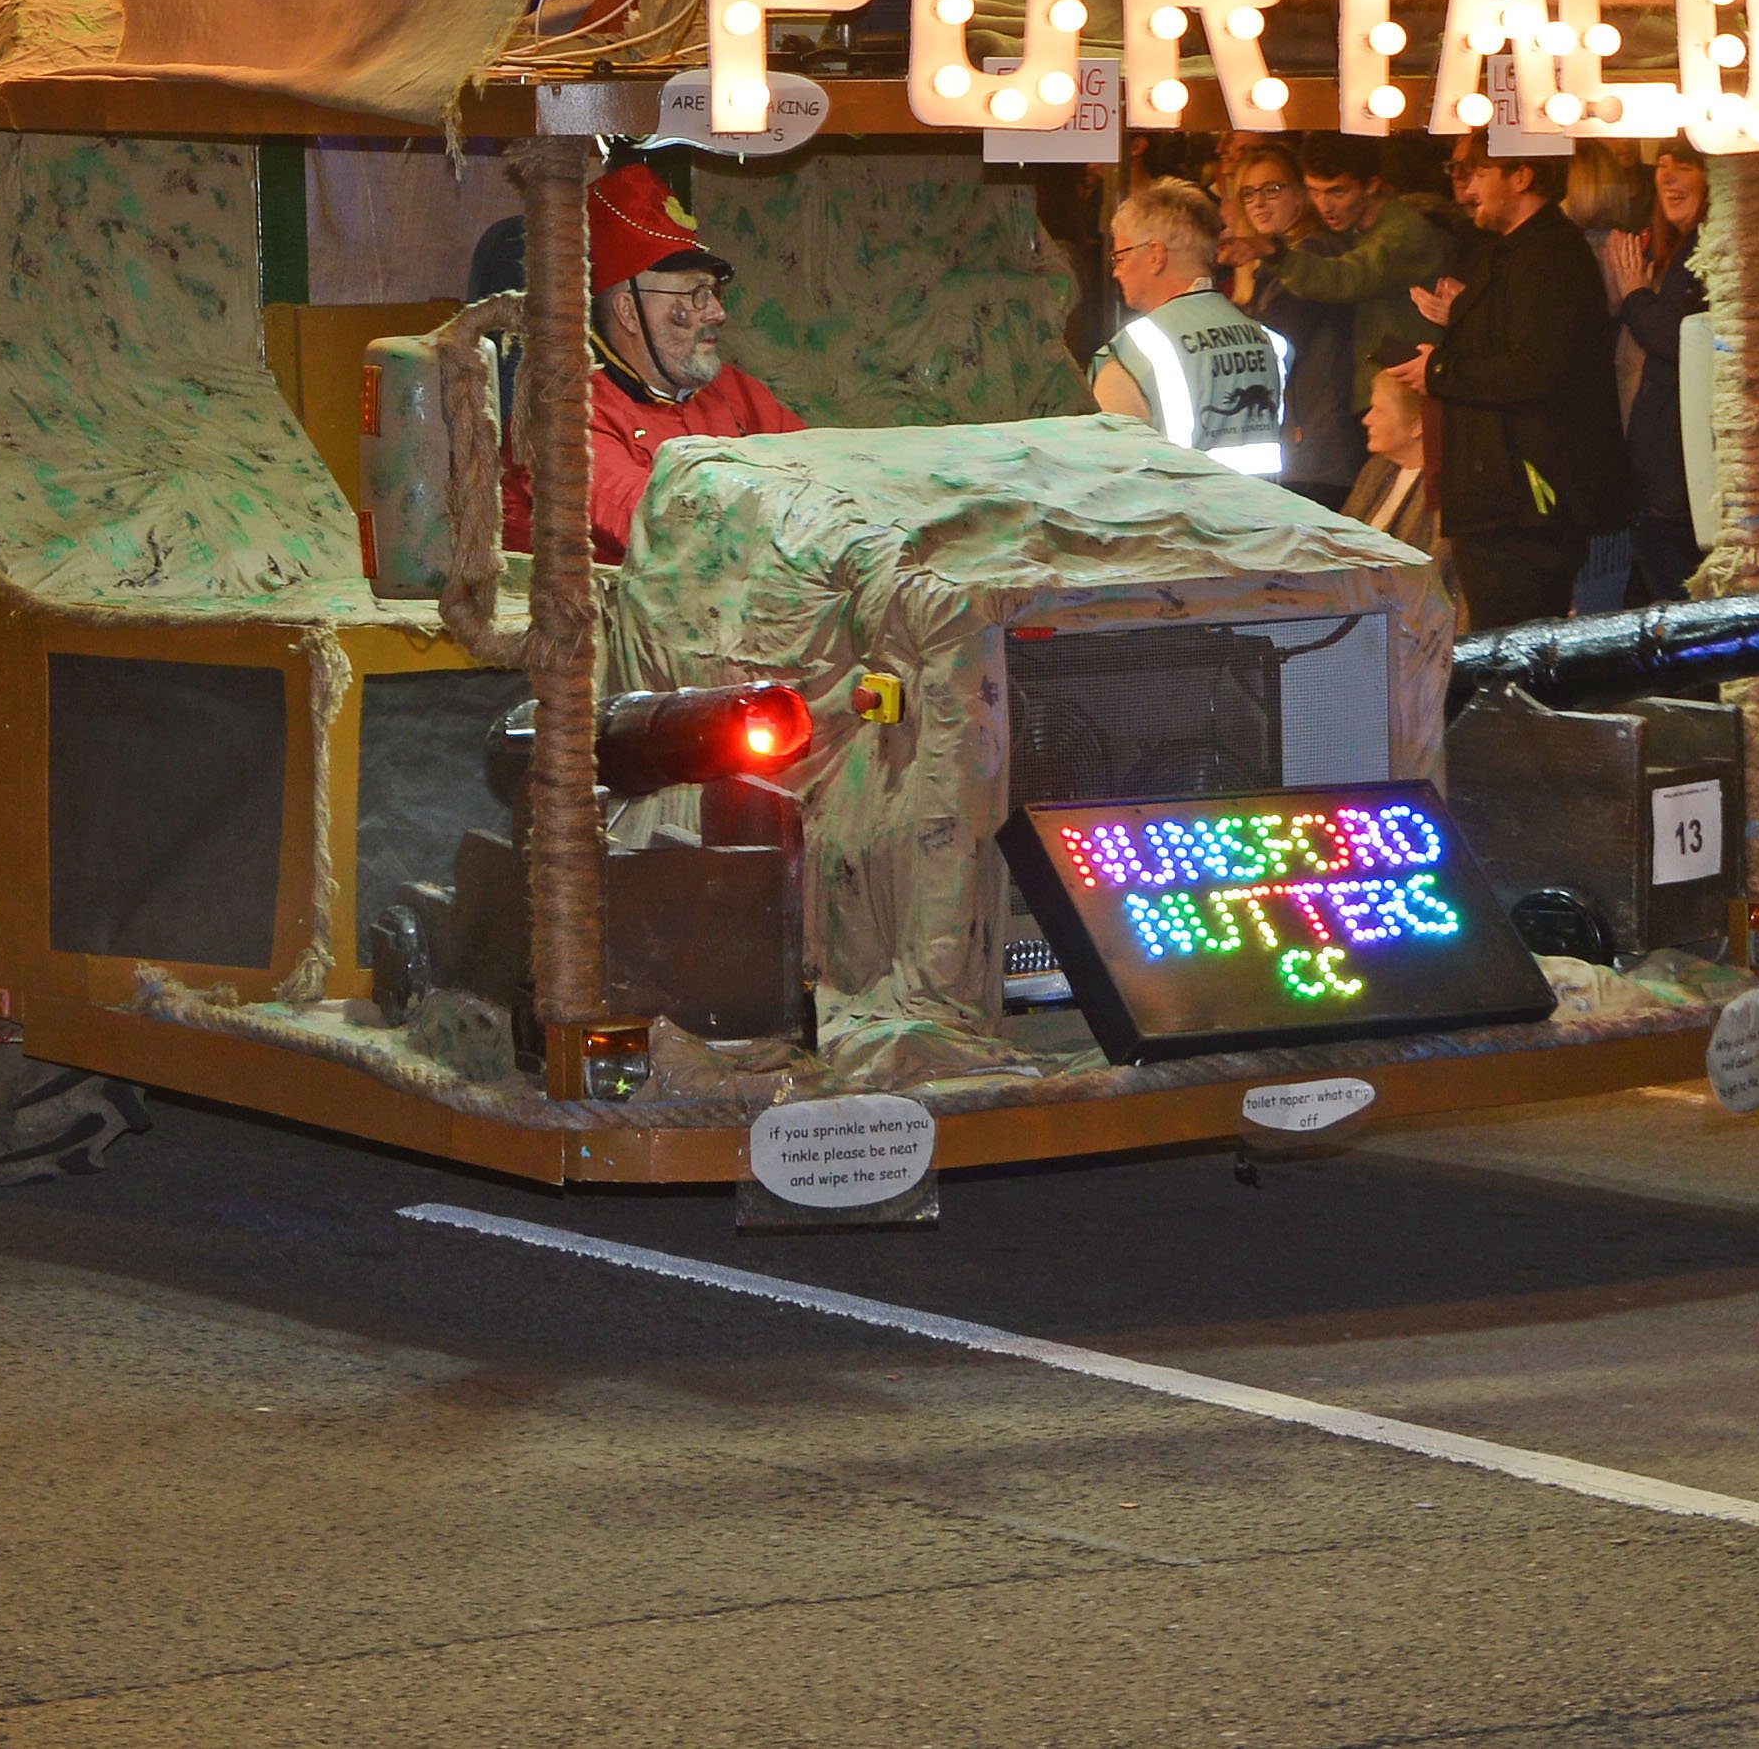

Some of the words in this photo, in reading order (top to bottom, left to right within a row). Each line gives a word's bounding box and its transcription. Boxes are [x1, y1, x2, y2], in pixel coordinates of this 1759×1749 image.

[671, 95, 706, 111] ARE
[1180, 323, 1269, 355] CARNIVA
[1211, 349, 1267, 378] JUDGE
[1060, 804, 1442, 889] NUNSFORD
[1674, 819, 1703, 855] 13
[1126, 873, 1459, 957] NUTTERS
[1281, 946, 1364, 997] CC
[1246, 1096, 1276, 1110] toilet
[1316, 1089, 1343, 1102] what
[1345, 1091, 1353, 1100] a
[769, 1126, 781, 1140] if
[785, 1128, 809, 1142] you
[813, 1123, 866, 1140] sprinkle
[870, 1120, 903, 1134] when
[906, 1118, 929, 1134] you
[1300, 1113, 1319, 1127] off
[781, 1148, 820, 1163] tinkle
[824, 1146, 866, 1164] please
[869, 1143, 886, 1157] be
[889, 1142, 919, 1155] neat
[790, 1173, 815, 1187] and
[818, 1172, 849, 1188] wipe
[853, 1170, 876, 1183] the
